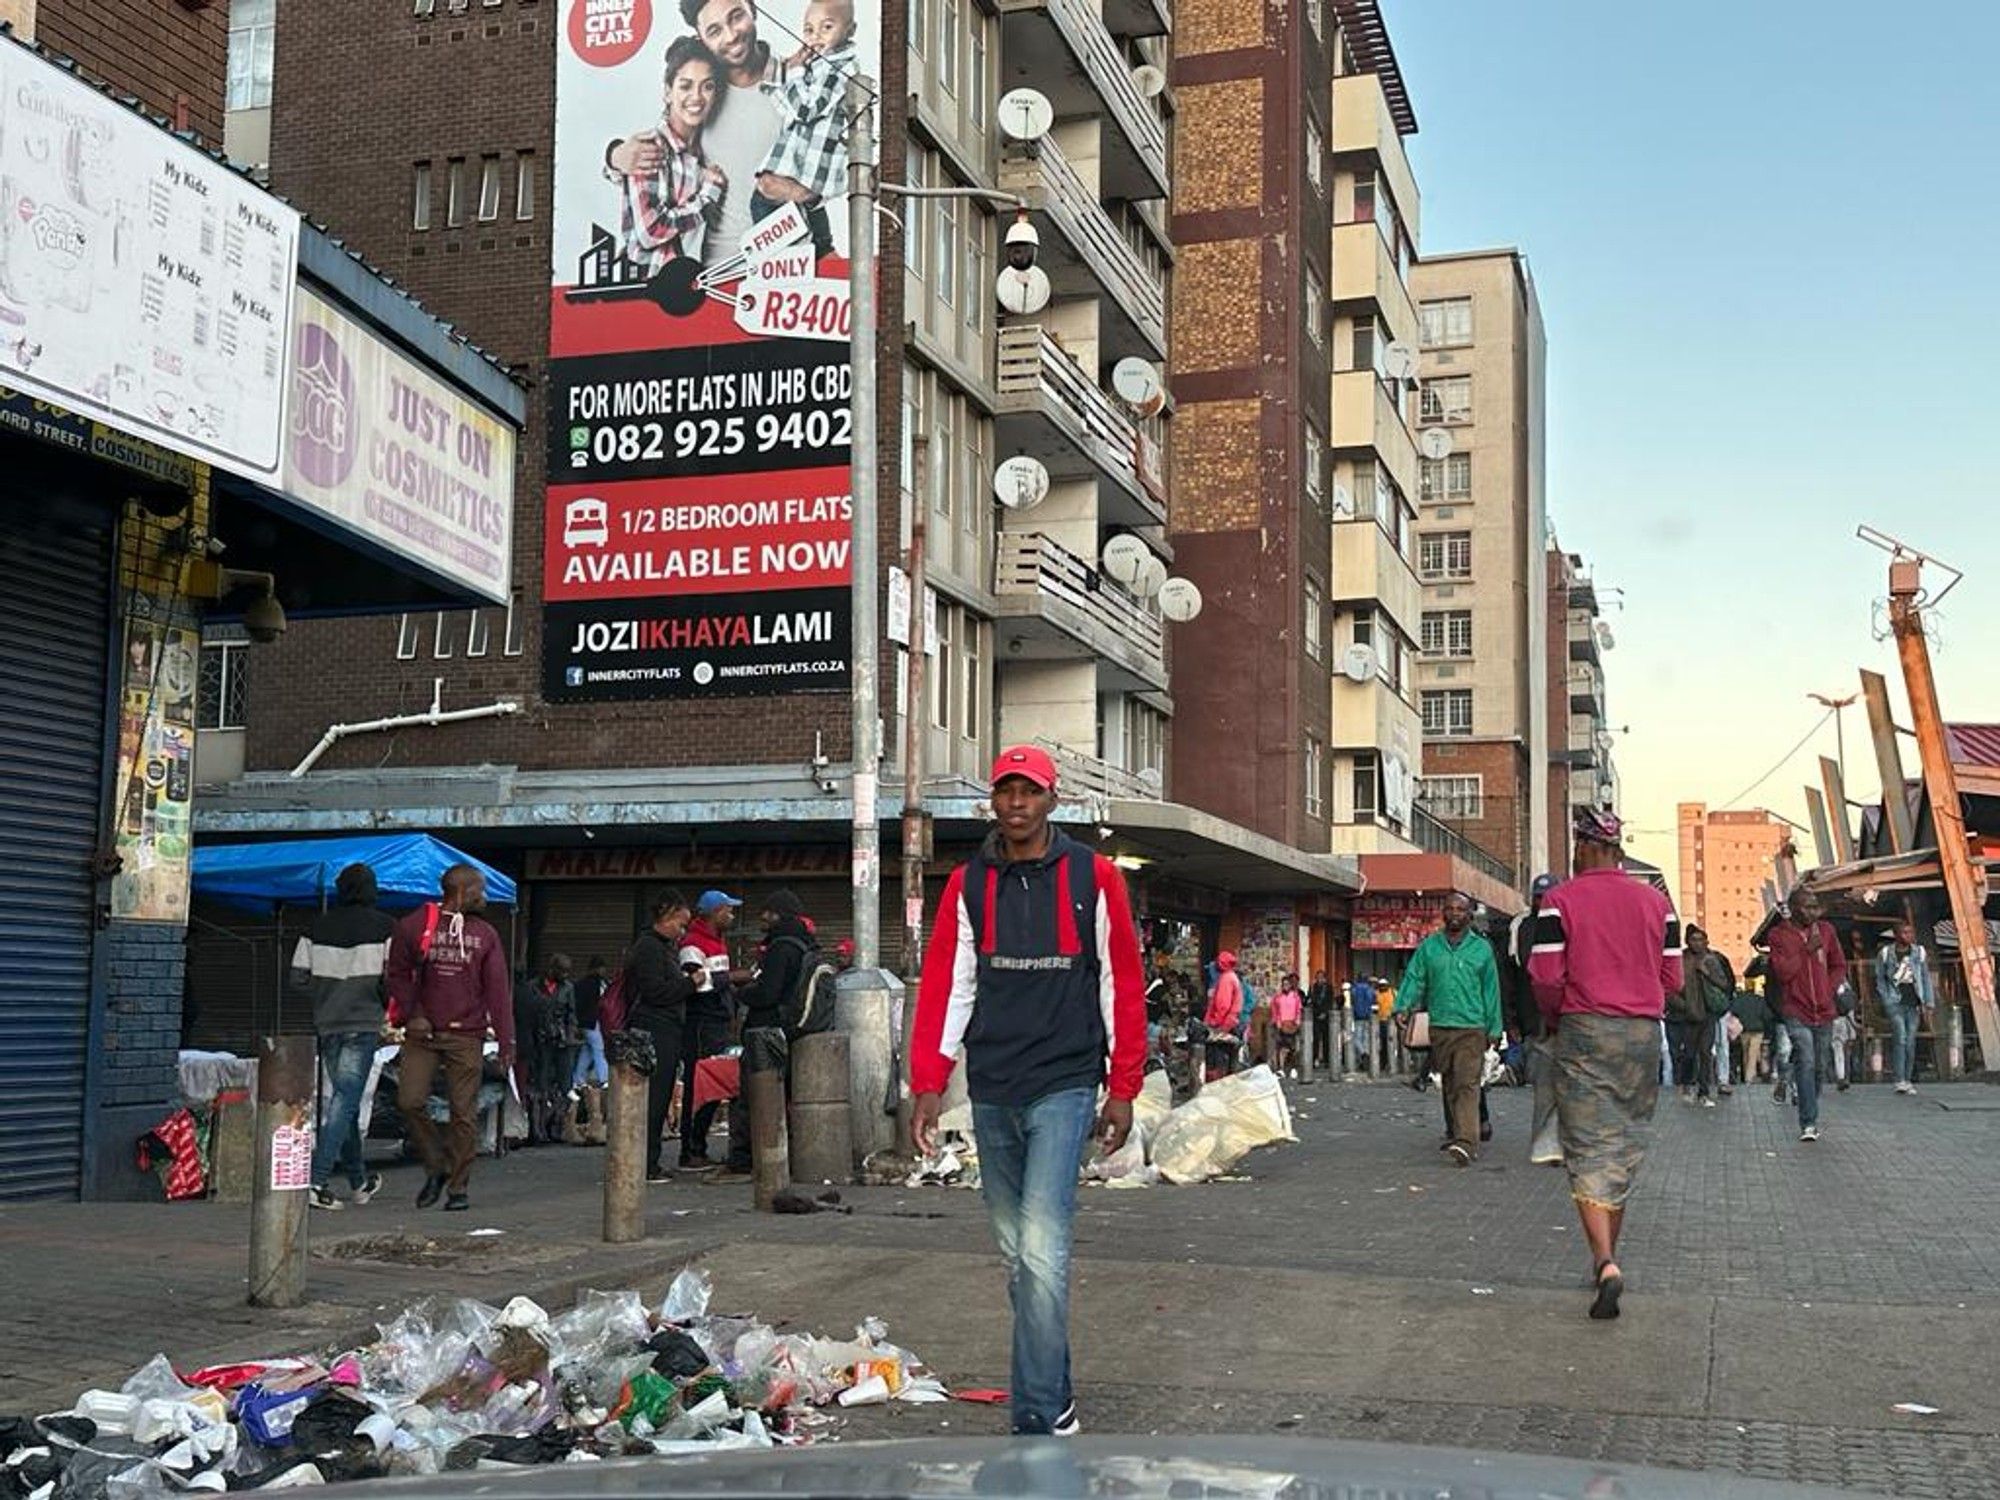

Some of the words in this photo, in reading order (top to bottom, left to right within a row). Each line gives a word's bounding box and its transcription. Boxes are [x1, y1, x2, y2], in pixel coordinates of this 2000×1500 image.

[585, 0, 635, 15] INNER
[585, 10, 635, 33] CITY
[585, 29, 634, 48] FLATS
[164, 160, 181, 185] My
[183, 171, 208, 197] Kidz
[238, 202, 253, 223] My
[254, 211, 278, 237] Kidz
[753, 213, 798, 251] FROM
[157, 253, 174, 277] My
[176, 262, 201, 287] Kidz
[761, 257, 810, 281] ONLY
[232, 289, 247, 313] My
[249, 299, 272, 323] Kidz
[762, 290, 850, 335] R3400
[569, 384, 610, 420] FOR
[613, 378, 673, 417] MORE
[676, 373, 737, 412] FLATS
[741, 371, 763, 407] IN
[766, 368, 806, 405] JHB
[810, 364, 851, 401] CBD
[388, 374, 451, 453] JUST
[457, 421, 492, 479] ON
[594, 423, 664, 463] 082
[674, 416, 746, 458] 925
[755, 408, 851, 452] 9402
[621, 508, 656, 535] 1/2
[661, 501, 779, 531] BEDROOM
[785, 496, 852, 523] FLATS
[563, 546, 751, 584] AVAILABLE
[761, 539, 850, 573] NOW
[720, 659, 846, 677] INNERCITYFLATS.CO.ZA
[537, 848, 657, 875] MALIK
[679, 845, 852, 874] CELLULA
